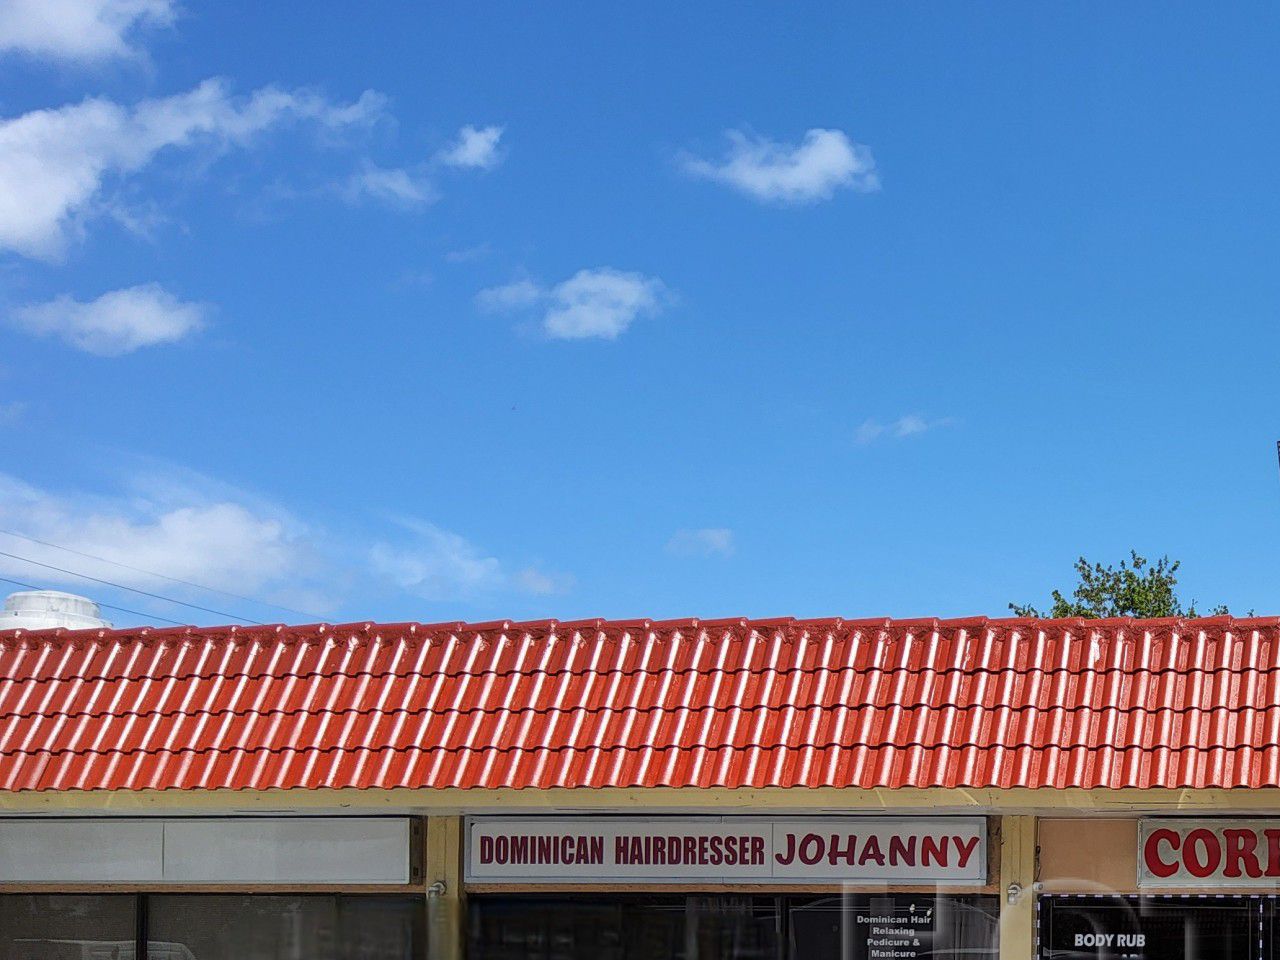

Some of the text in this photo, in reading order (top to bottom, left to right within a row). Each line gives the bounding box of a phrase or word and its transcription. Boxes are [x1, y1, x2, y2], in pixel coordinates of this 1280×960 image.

[479, 833, 980, 868] DOMINICAN HAIRDRESSER JOHANNY
[857, 915, 932, 924] Dominican Hair
[872, 927, 915, 937] Relaxing
[867, 938, 921, 947] Pedicure &
[1074, 933, 1146, 947] BODY RUB
[871, 950, 917, 958] Manicure
